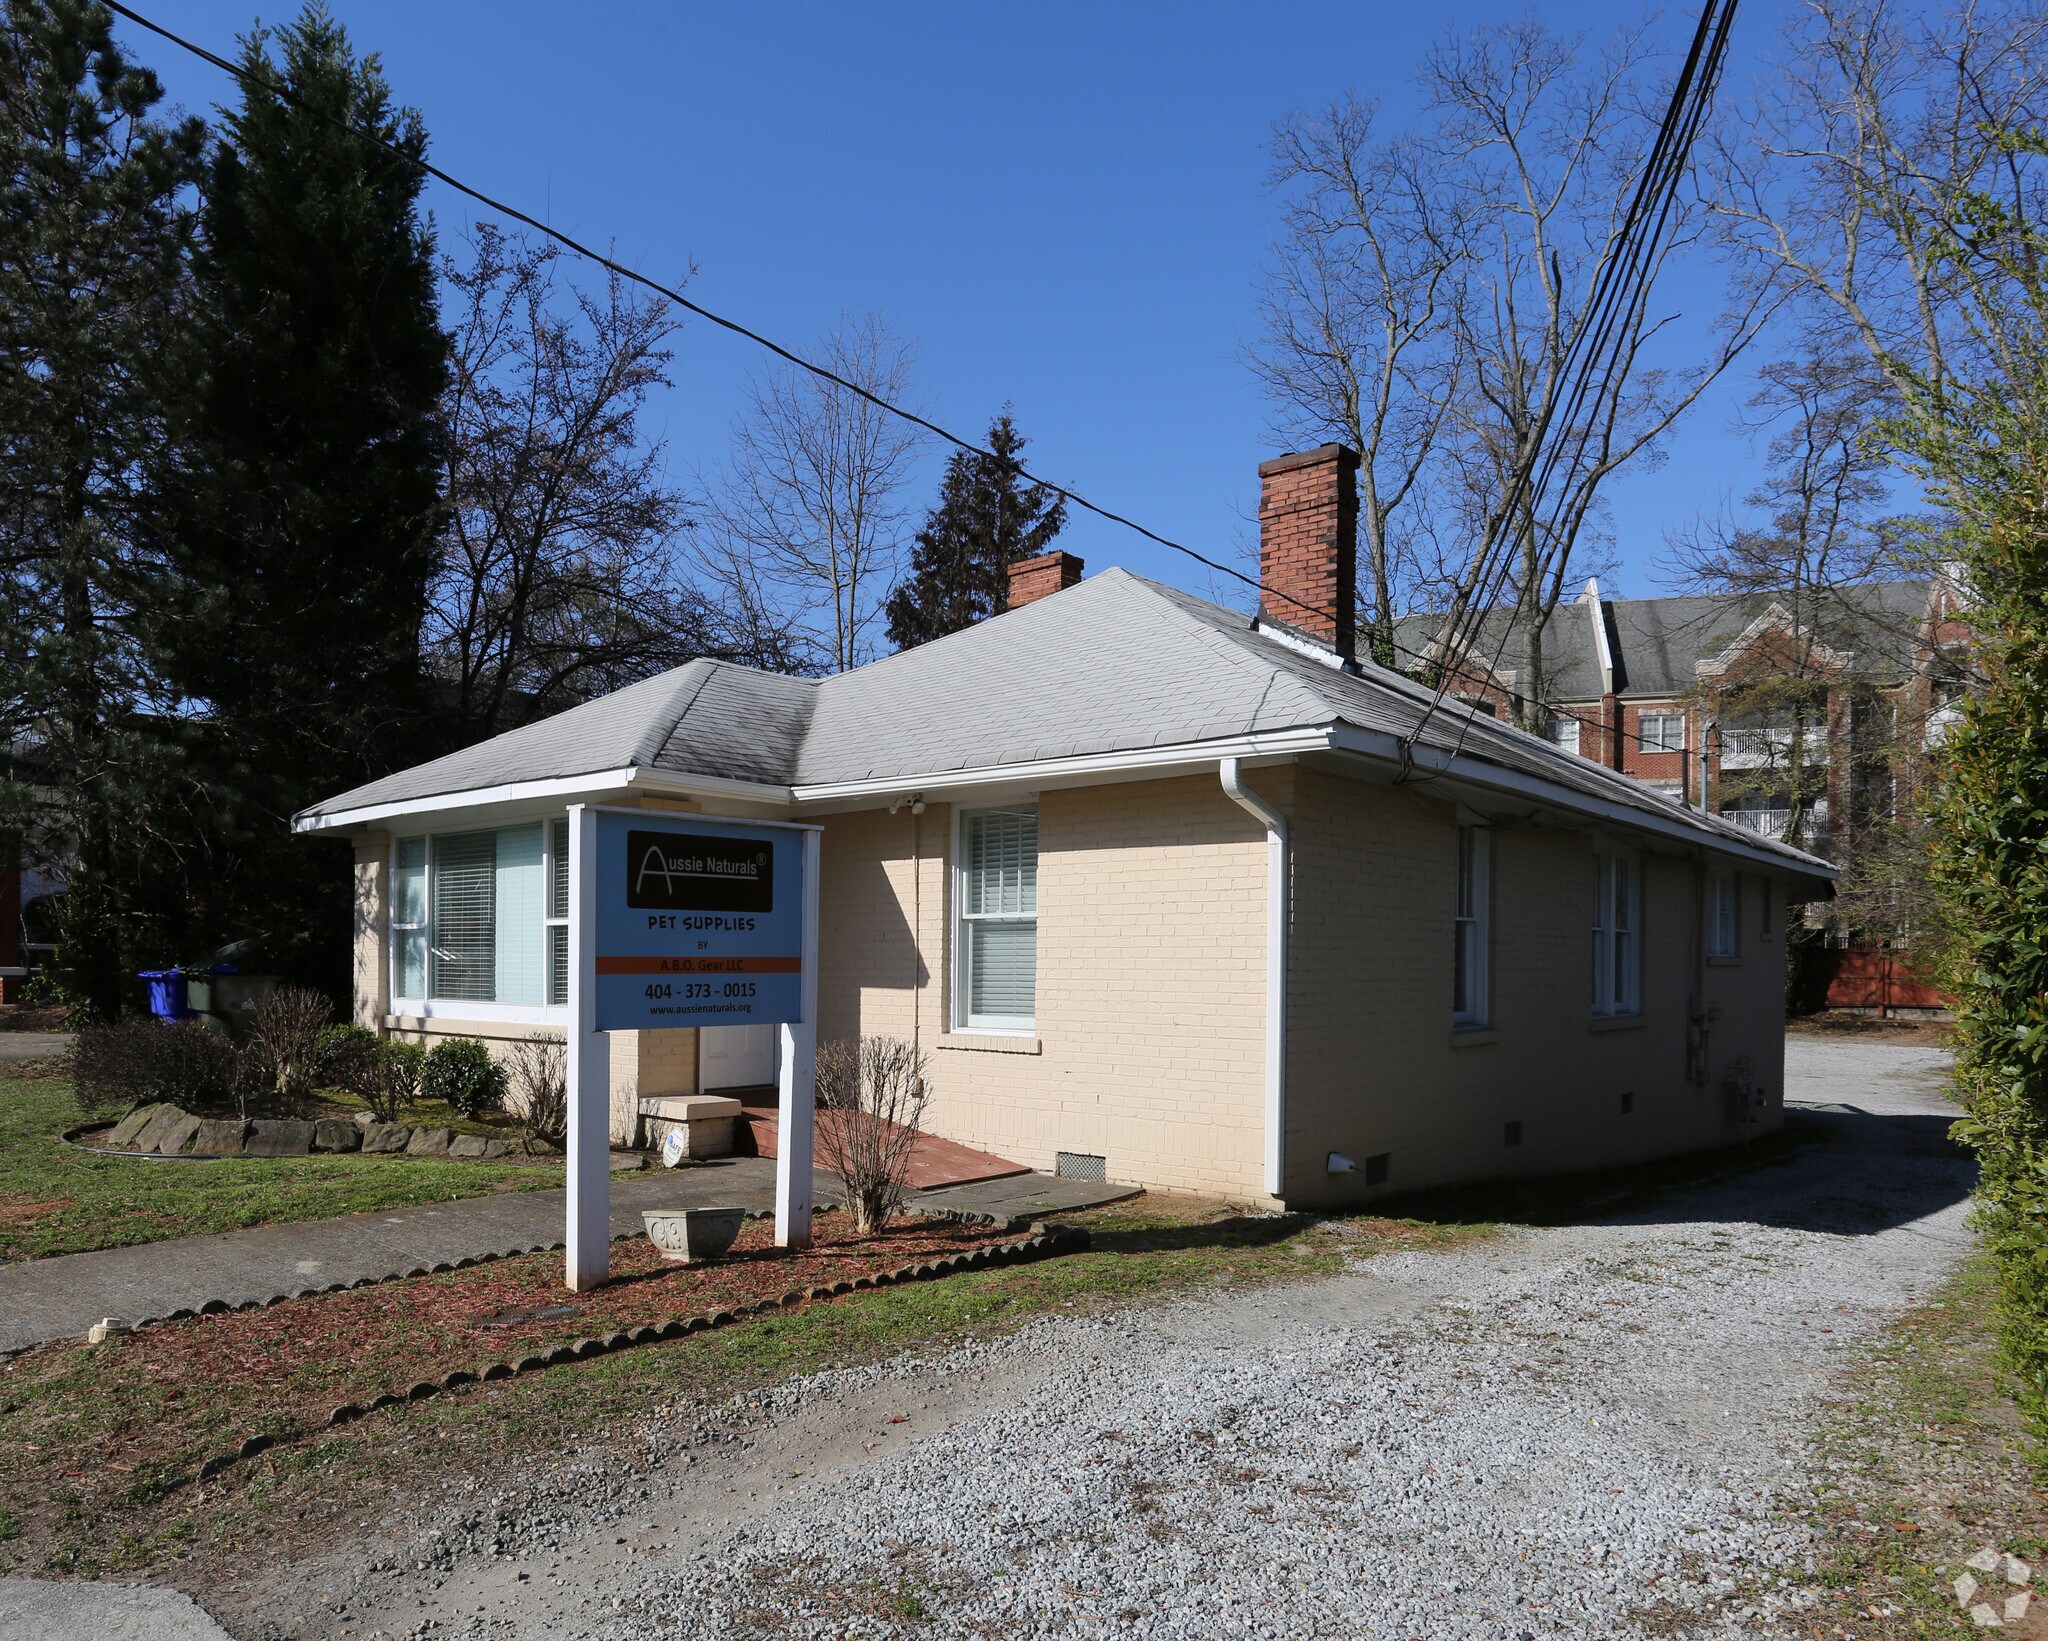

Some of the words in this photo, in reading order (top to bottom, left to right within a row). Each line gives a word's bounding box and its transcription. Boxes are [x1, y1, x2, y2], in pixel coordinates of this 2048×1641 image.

[636, 846, 703, 895] Aussie
[648, 916, 676, 929] PET
[683, 916, 755, 931] SUPPLIES
[698, 941, 708, 950] BY
[661, 960, 695, 971] A.B.O.
[698, 960, 723, 971] Gear
[727, 960, 743, 971] LLC
[645, 984, 672, 999] 404
[685, 984, 711, 998] 373
[724, 983, 756, 997] 0015
[650, 1003, 752, 1014] www.aussienaturals.org
